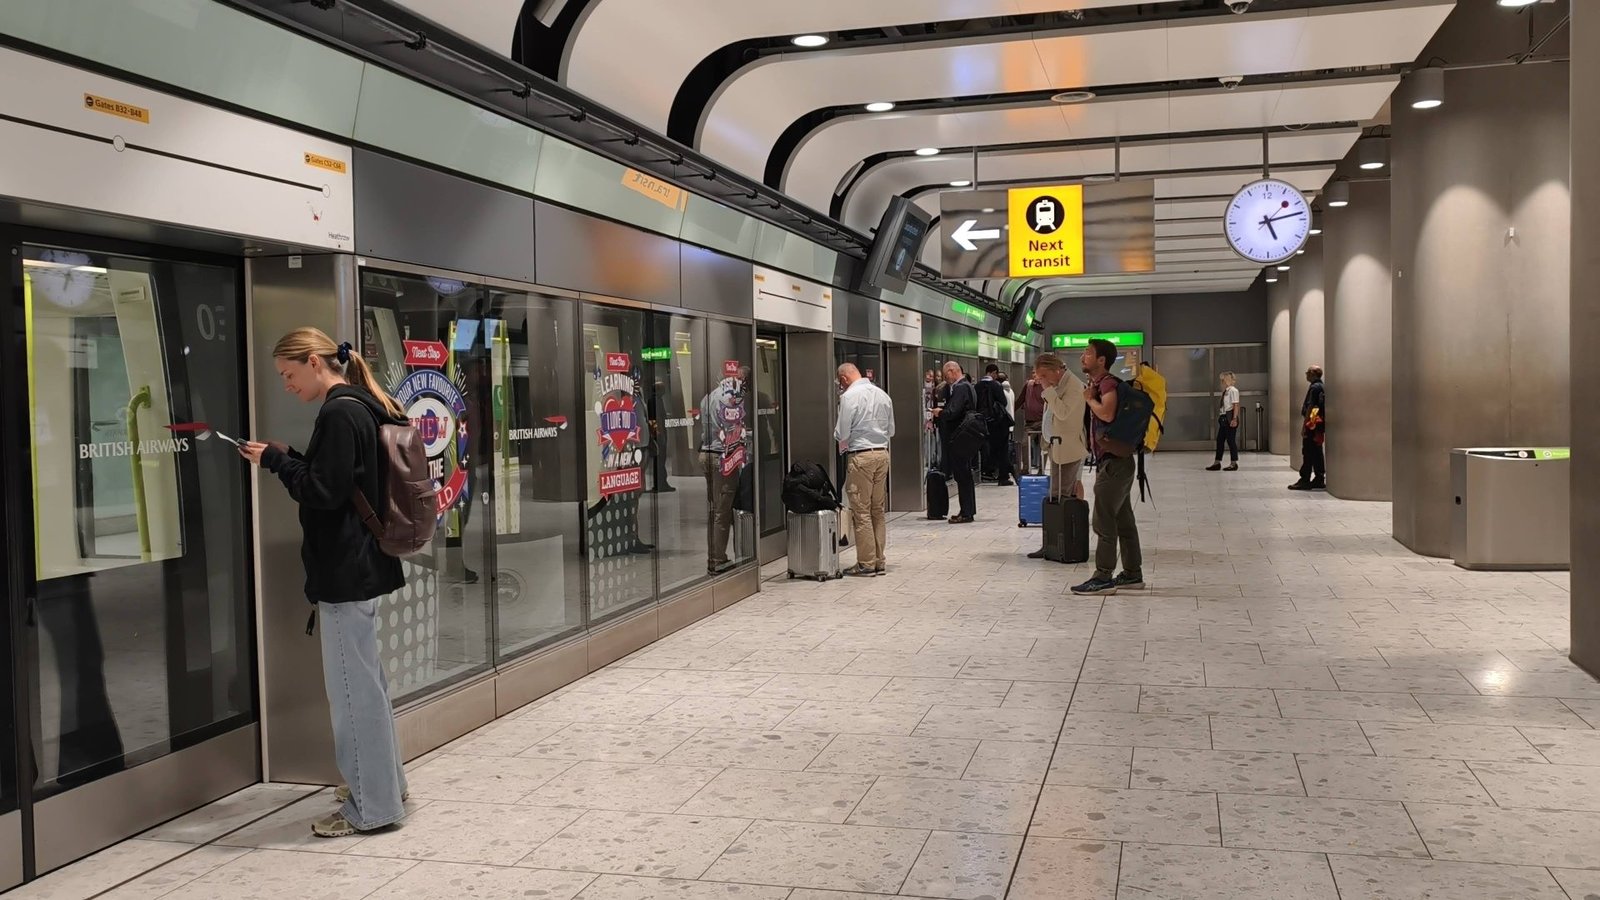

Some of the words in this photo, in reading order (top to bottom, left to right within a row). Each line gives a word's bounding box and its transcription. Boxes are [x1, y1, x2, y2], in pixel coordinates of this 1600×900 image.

[95, 99, 114, 111] Gates
[115, 105, 142, 118] B32-B48
[1263, 192, 1272, 200] 12
[1029, 240, 1064, 252] Next
[1022, 254, 1071, 268] transit
[411, 373, 428, 393] NEW
[428, 373, 459, 407] FAVOURITE
[600, 374, 635, 396] LEARNING
[610, 410, 621, 430] LOVE
[508, 428, 533, 441] BRITISH
[533, 427, 558, 439] AIRWAYS
[79, 441, 134, 459] BRITISH
[136, 438, 189, 454] AIRWAYS
[428, 457, 444, 480] THE
[601, 471, 639, 490] LANGUAGE
